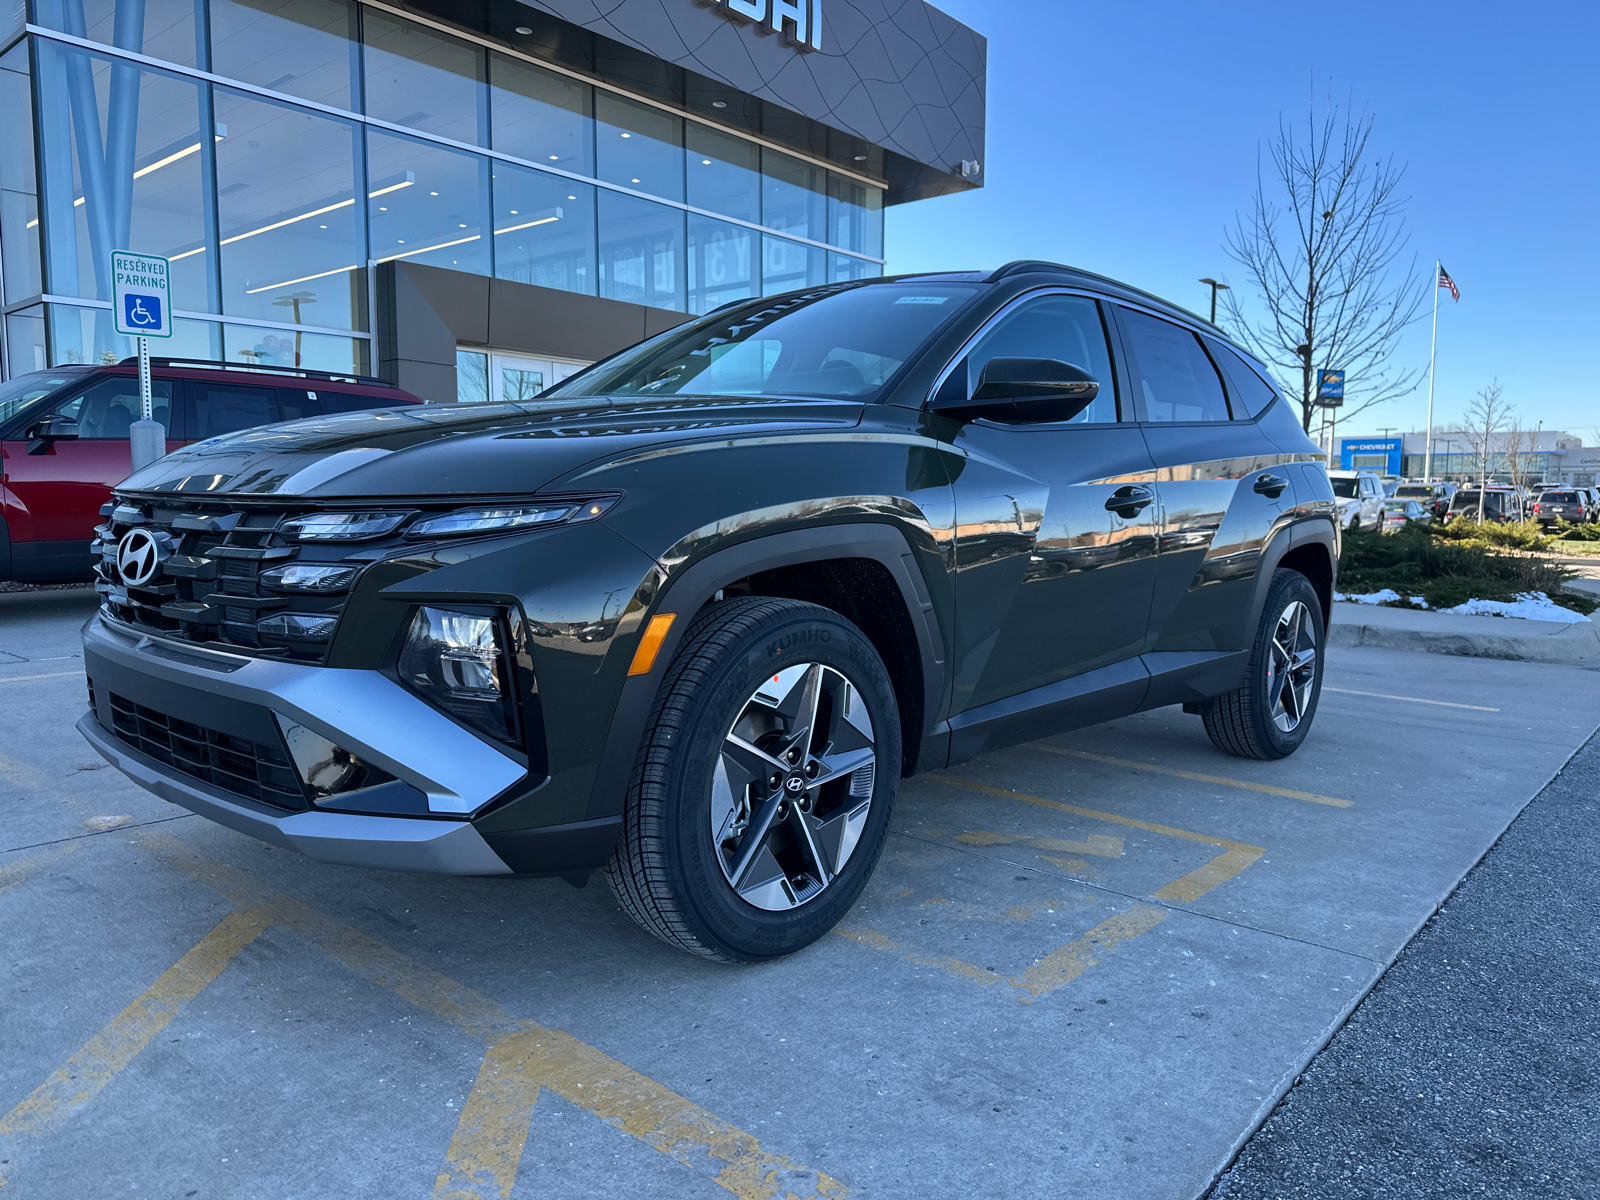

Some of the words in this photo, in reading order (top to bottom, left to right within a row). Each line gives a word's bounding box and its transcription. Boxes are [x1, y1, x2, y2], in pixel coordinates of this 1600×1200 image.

[117, 259, 164, 274] RESERVED
[117, 273, 165, 288] PARKING
[766, 629, 831, 658] KUMHO
